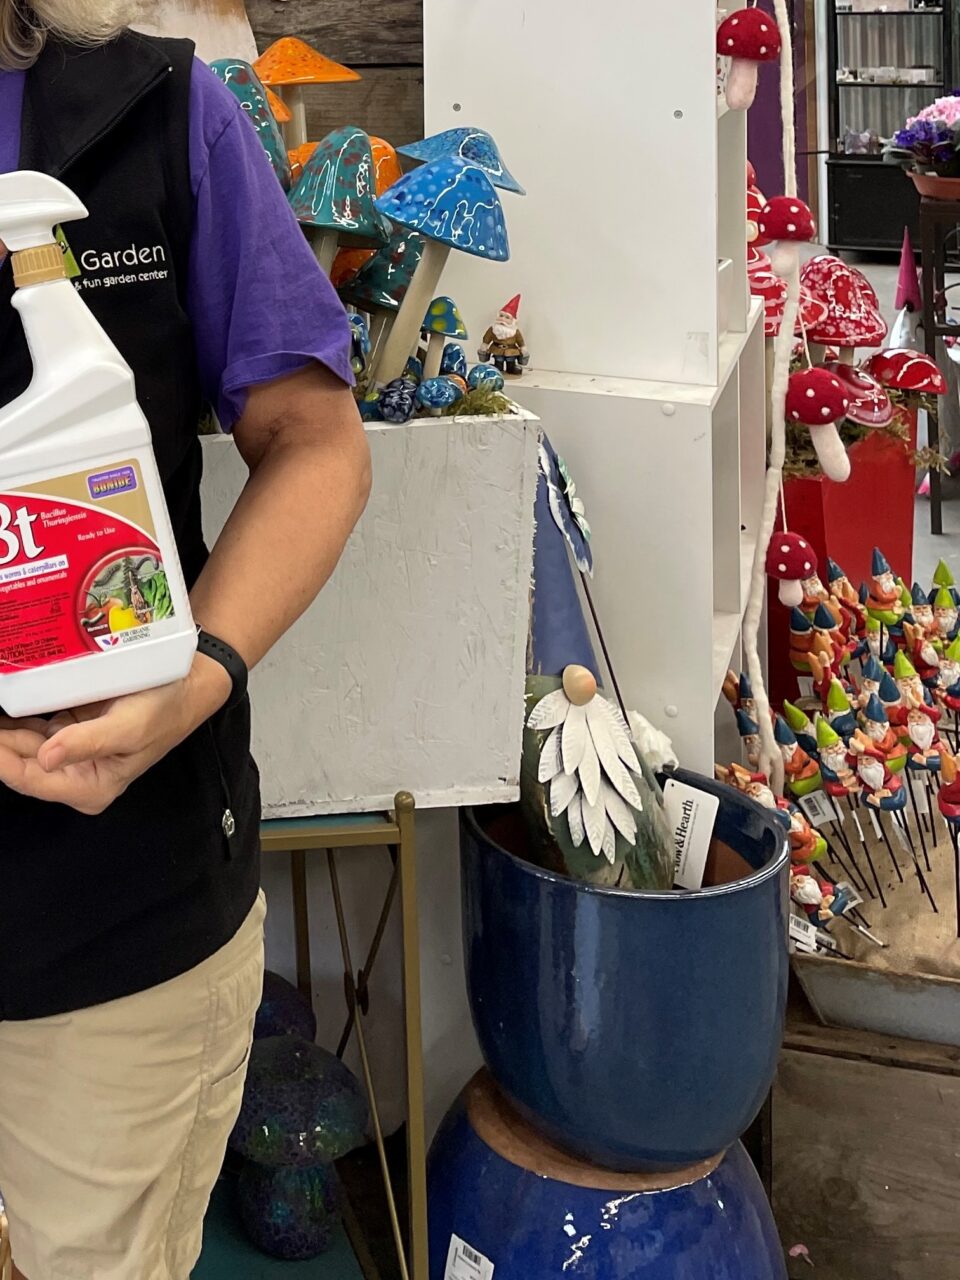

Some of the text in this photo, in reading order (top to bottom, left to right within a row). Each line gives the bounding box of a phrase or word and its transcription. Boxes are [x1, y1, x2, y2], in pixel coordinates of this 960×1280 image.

[81, 243, 166, 270] Garden
[83, 278, 101, 288] fun
[103, 274, 137, 287] garden
[138, 270, 168, 281] center
[40, 508, 67, 520] Bacillus
[42, 512, 87, 528] Thuringiensis
[77, 531, 95, 541] Ready
[104, 527, 115, 535] Use
[0, 579, 26, 593] vegetables
[26, 577, 36, 586] and
[37, 571, 68, 585] ornamentals
[4, 571, 21, 580] worms
